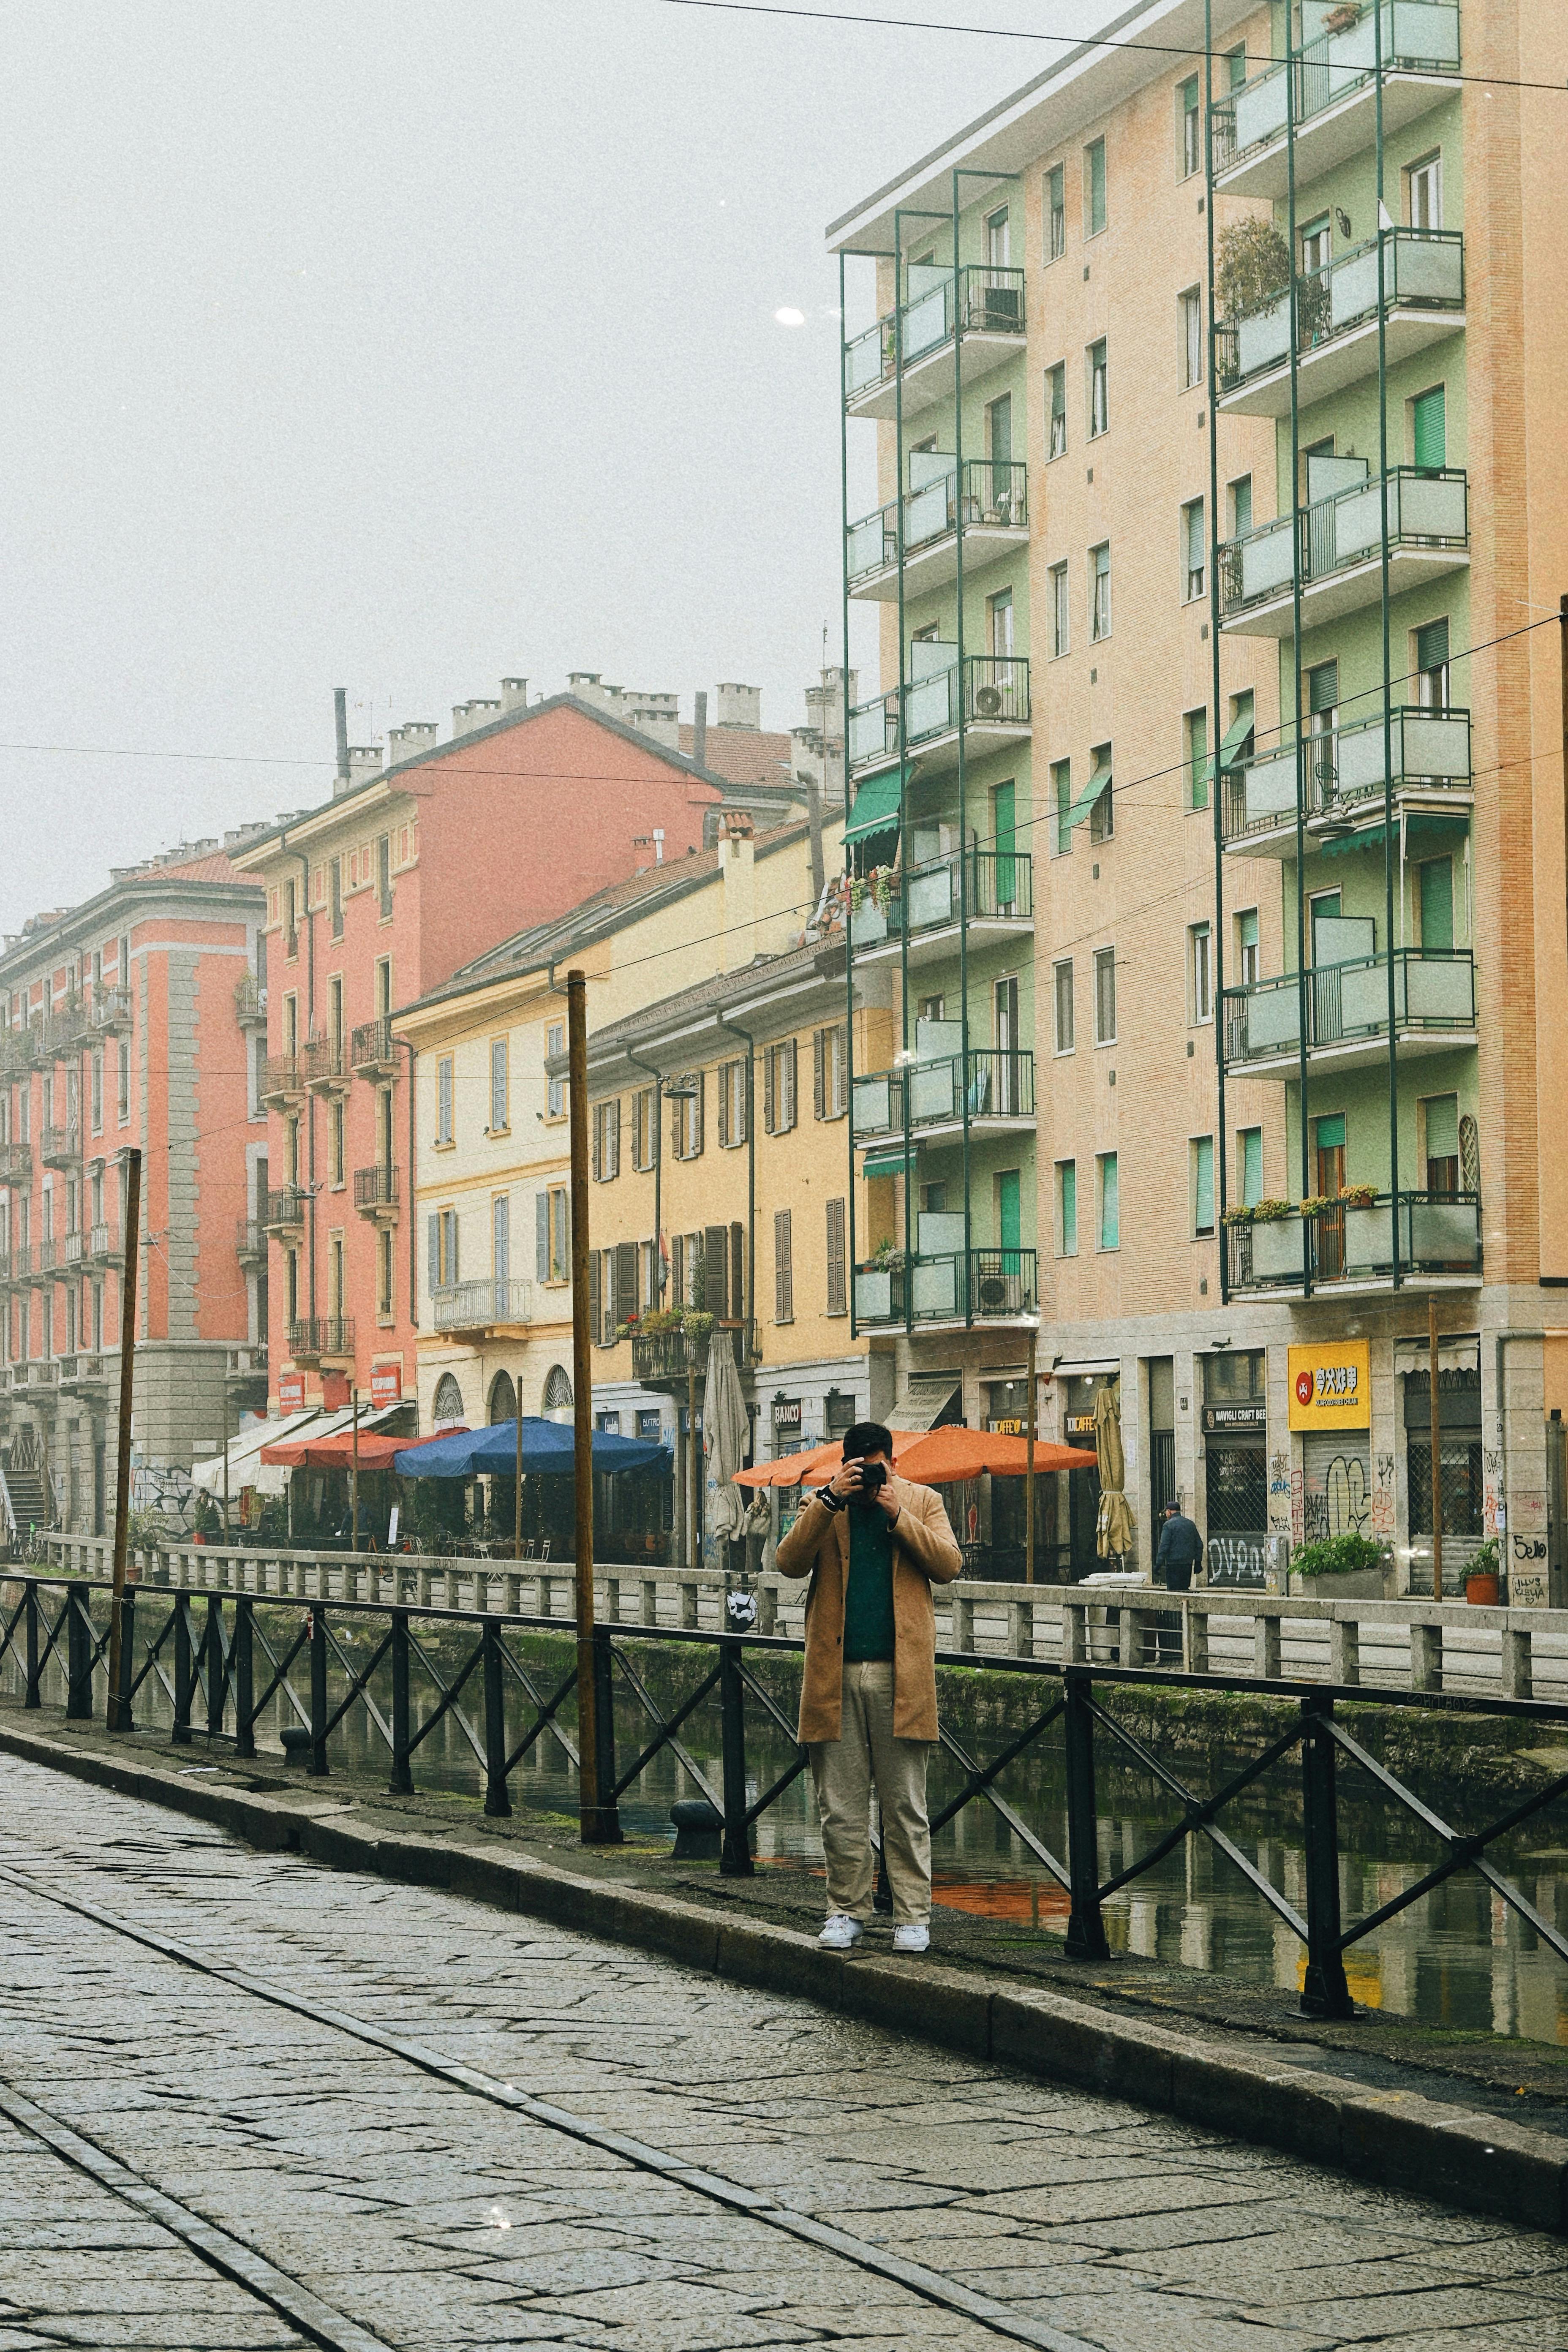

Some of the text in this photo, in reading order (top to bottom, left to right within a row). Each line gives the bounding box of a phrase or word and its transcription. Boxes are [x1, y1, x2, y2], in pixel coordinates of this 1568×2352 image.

[1181, 1398, 1186, 1407] 44
[775, 1405, 799, 1423] BANCO
[1216, 1410, 1237, 1421] NAVIGLI
[1238, 1410, 1255, 1420] CRAFT
[643, 1418, 660, 1427] BISTRO
